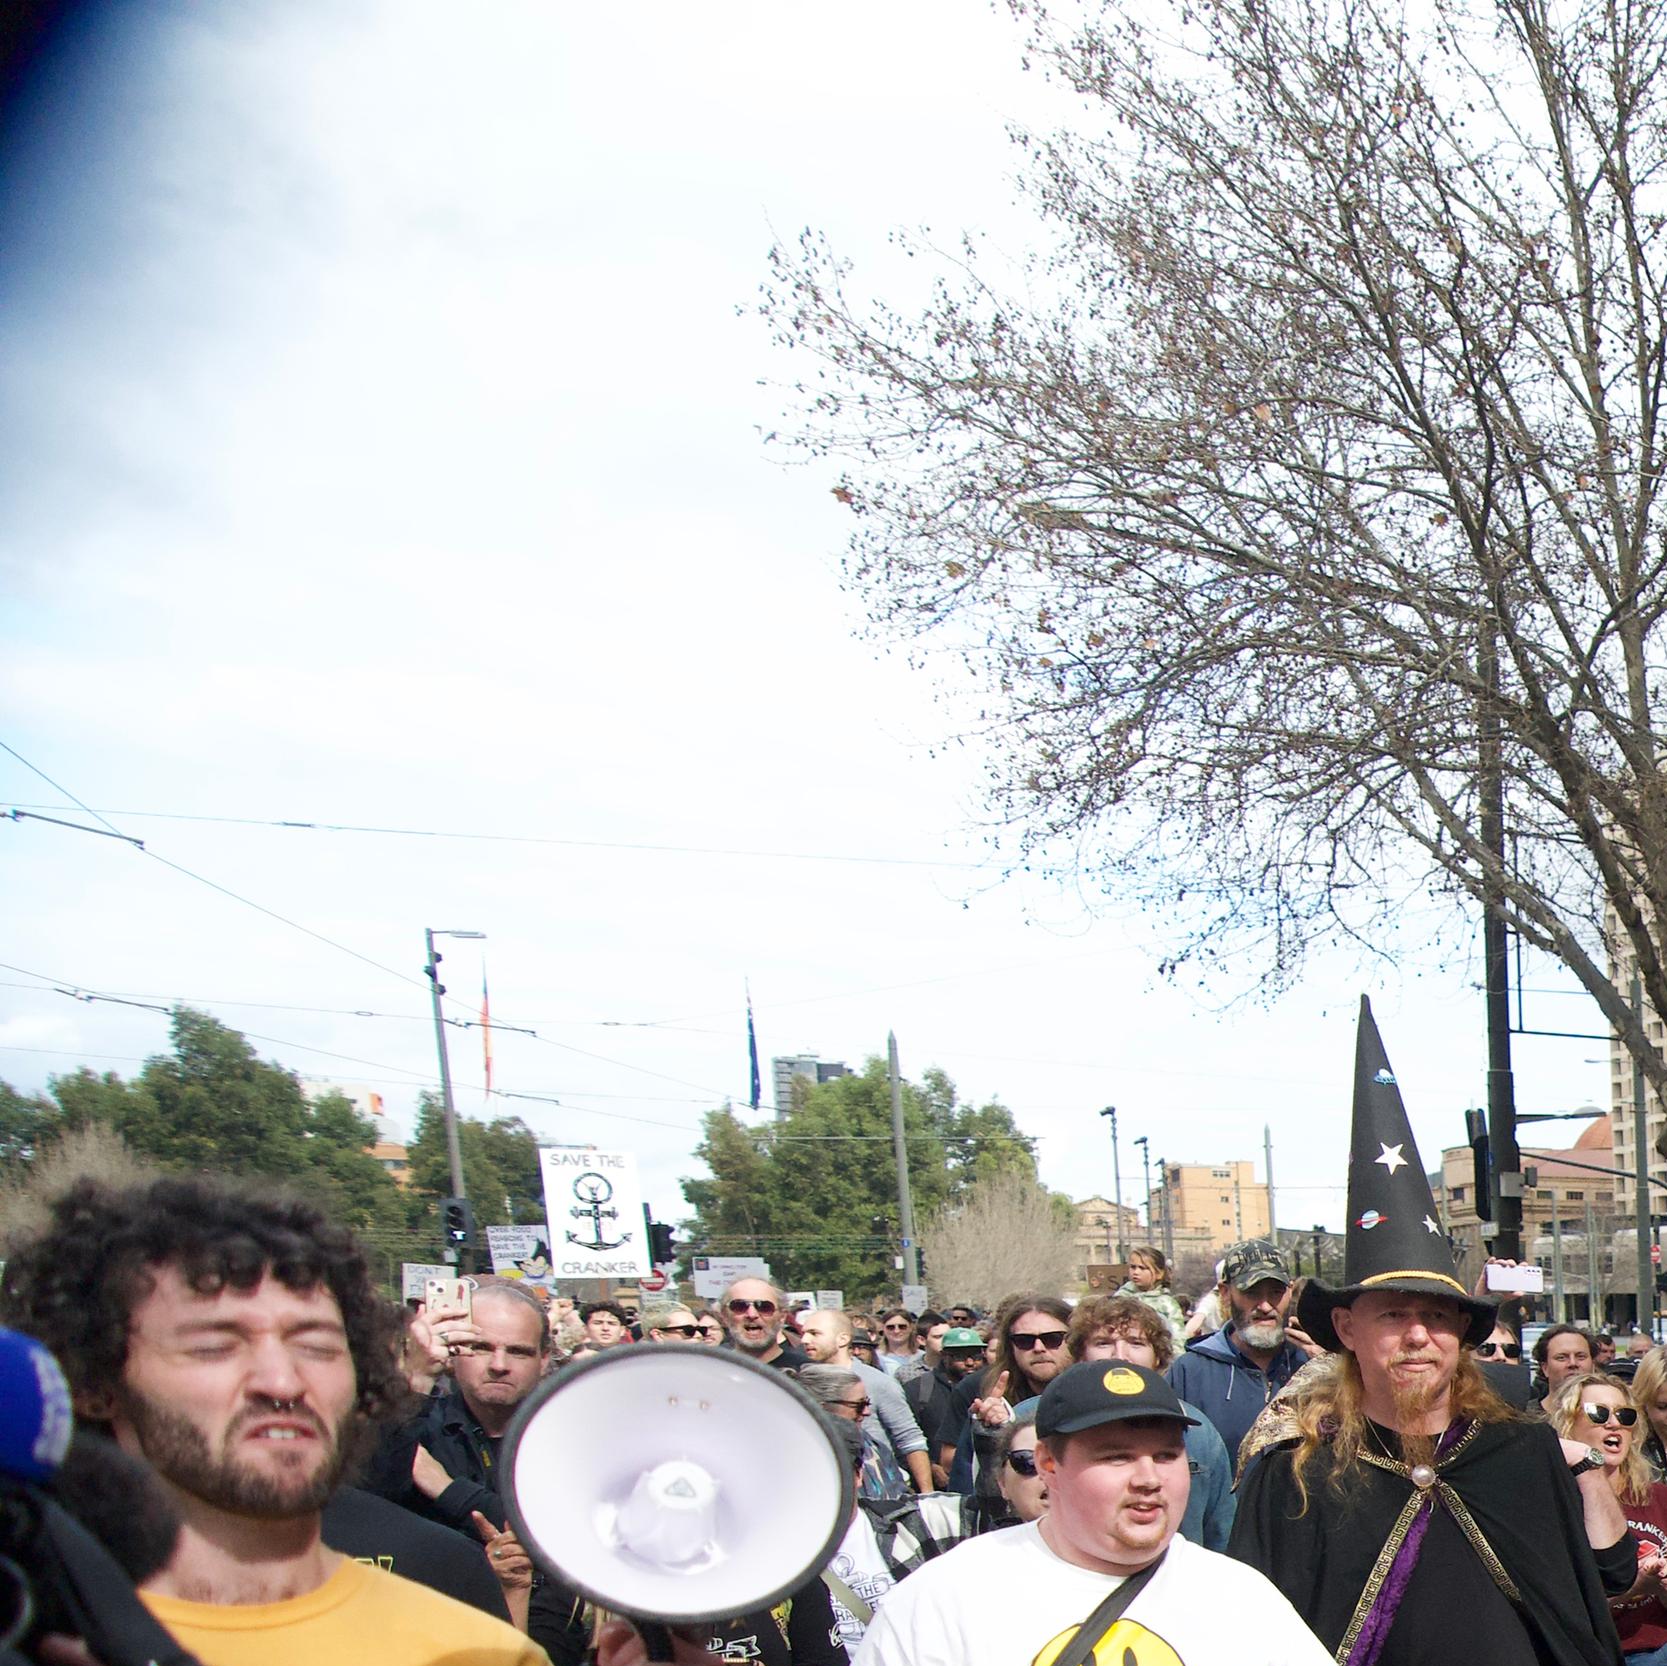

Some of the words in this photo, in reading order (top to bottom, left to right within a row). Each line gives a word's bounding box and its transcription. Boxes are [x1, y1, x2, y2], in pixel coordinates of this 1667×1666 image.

[550, 1153, 591, 1167] SAVE
[598, 1154, 625, 1169] THE
[561, 1260, 639, 1275] CRANKER
